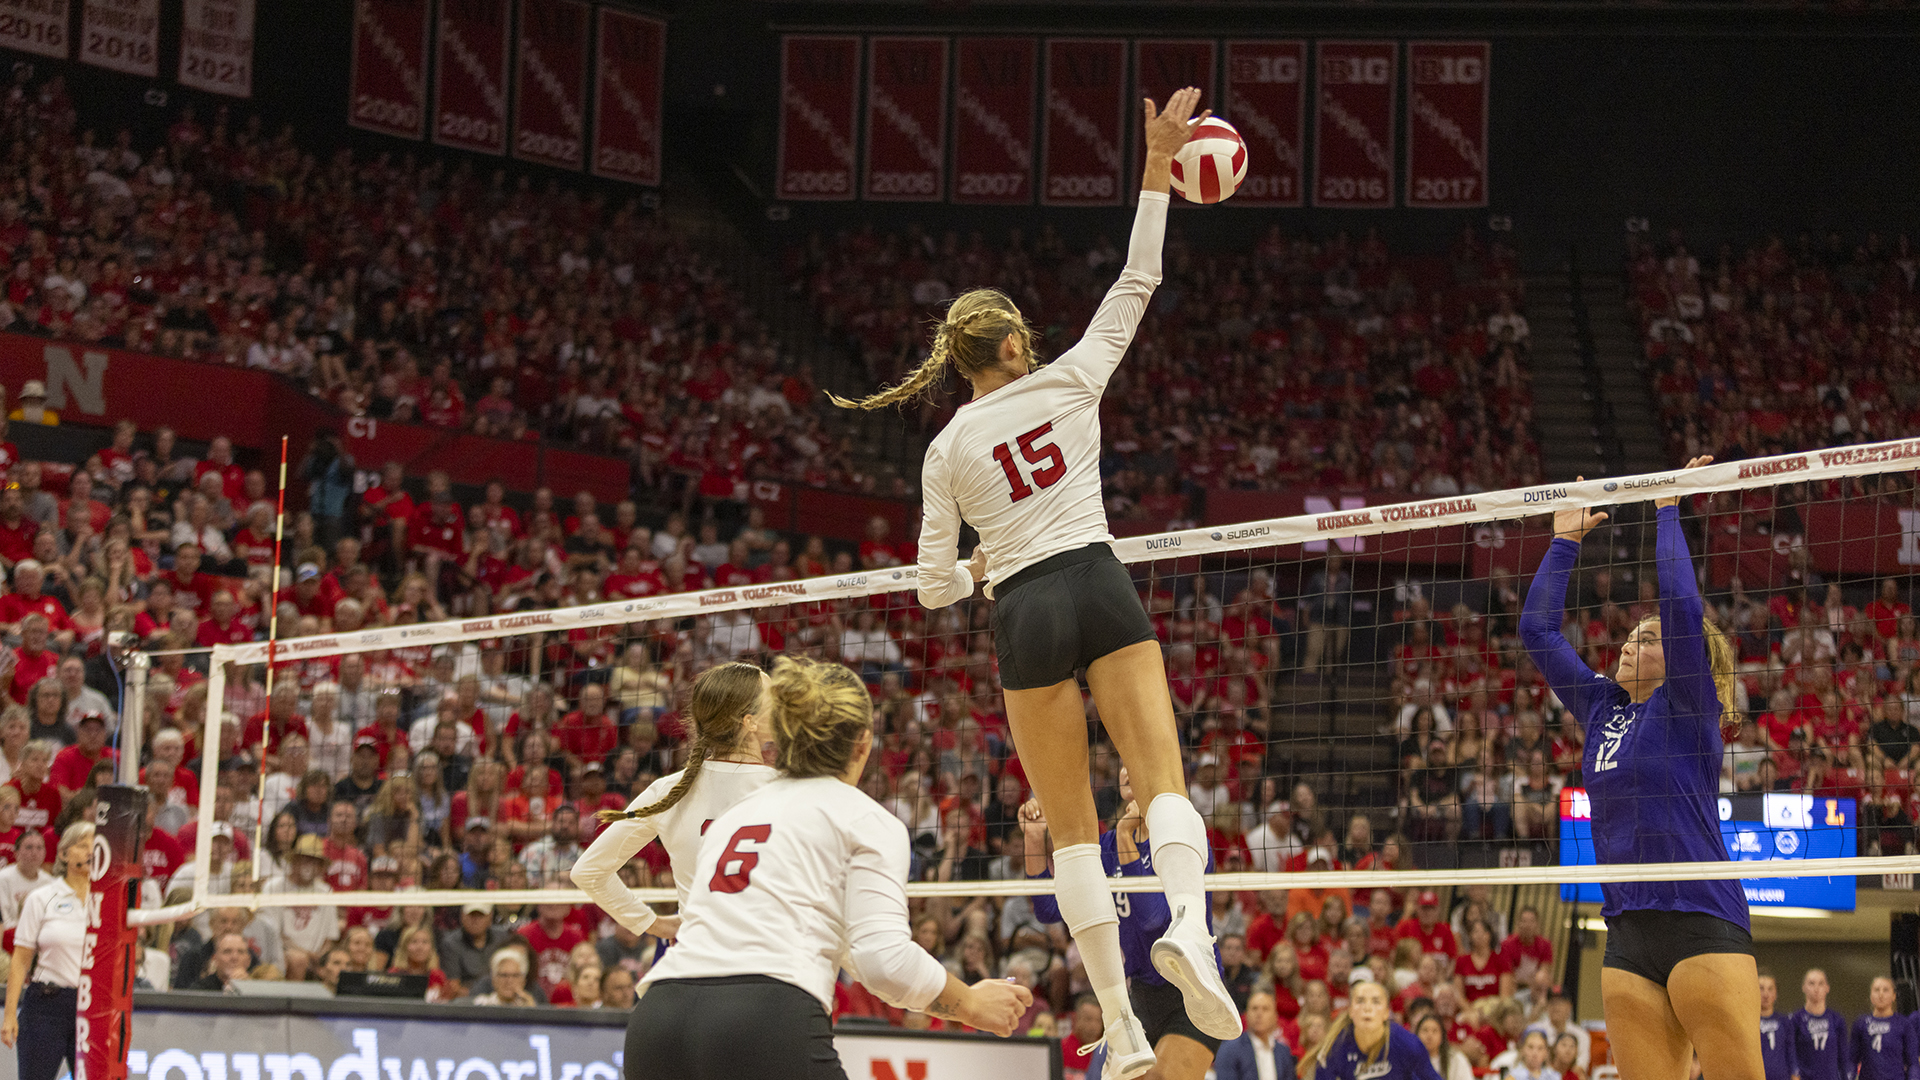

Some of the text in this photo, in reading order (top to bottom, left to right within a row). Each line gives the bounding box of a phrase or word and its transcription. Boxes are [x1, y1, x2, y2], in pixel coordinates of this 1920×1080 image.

[0, 14, 63, 46] 2016
[88, 32, 154, 65] 2018
[186, 53, 247, 85] 2021
[442, 113, 499, 143] 2001
[786, 171, 847, 193] 2005
[872, 172, 934, 194] 2006
[959, 173, 1023, 195] 2007
[1050, 175, 1114, 197] 2008
[1324, 177, 1384, 199] 2016
[1416, 177, 1477, 199] 2017
[42, 345, 109, 416] N
[347, 417, 377, 440] C1
[992, 421, 1067, 503] 15
[837, 576, 867, 589] DUTEAU
[1146, 536, 1182, 550] DUTEAU
[1226, 526, 1270, 540] SUBARU
[1316, 511, 1373, 532] HUSKER
[1380, 498, 1477, 523] VOLLEYBALL
[1523, 487, 1568, 503] DUTEAU
[1623, 475, 1677, 490] SUBARU
[1737, 454, 1810, 479] HUSKER
[1594, 738, 1621, 773] 12
[708, 823, 772, 894] 6
[1812, 1031, 1829, 1051] 17
